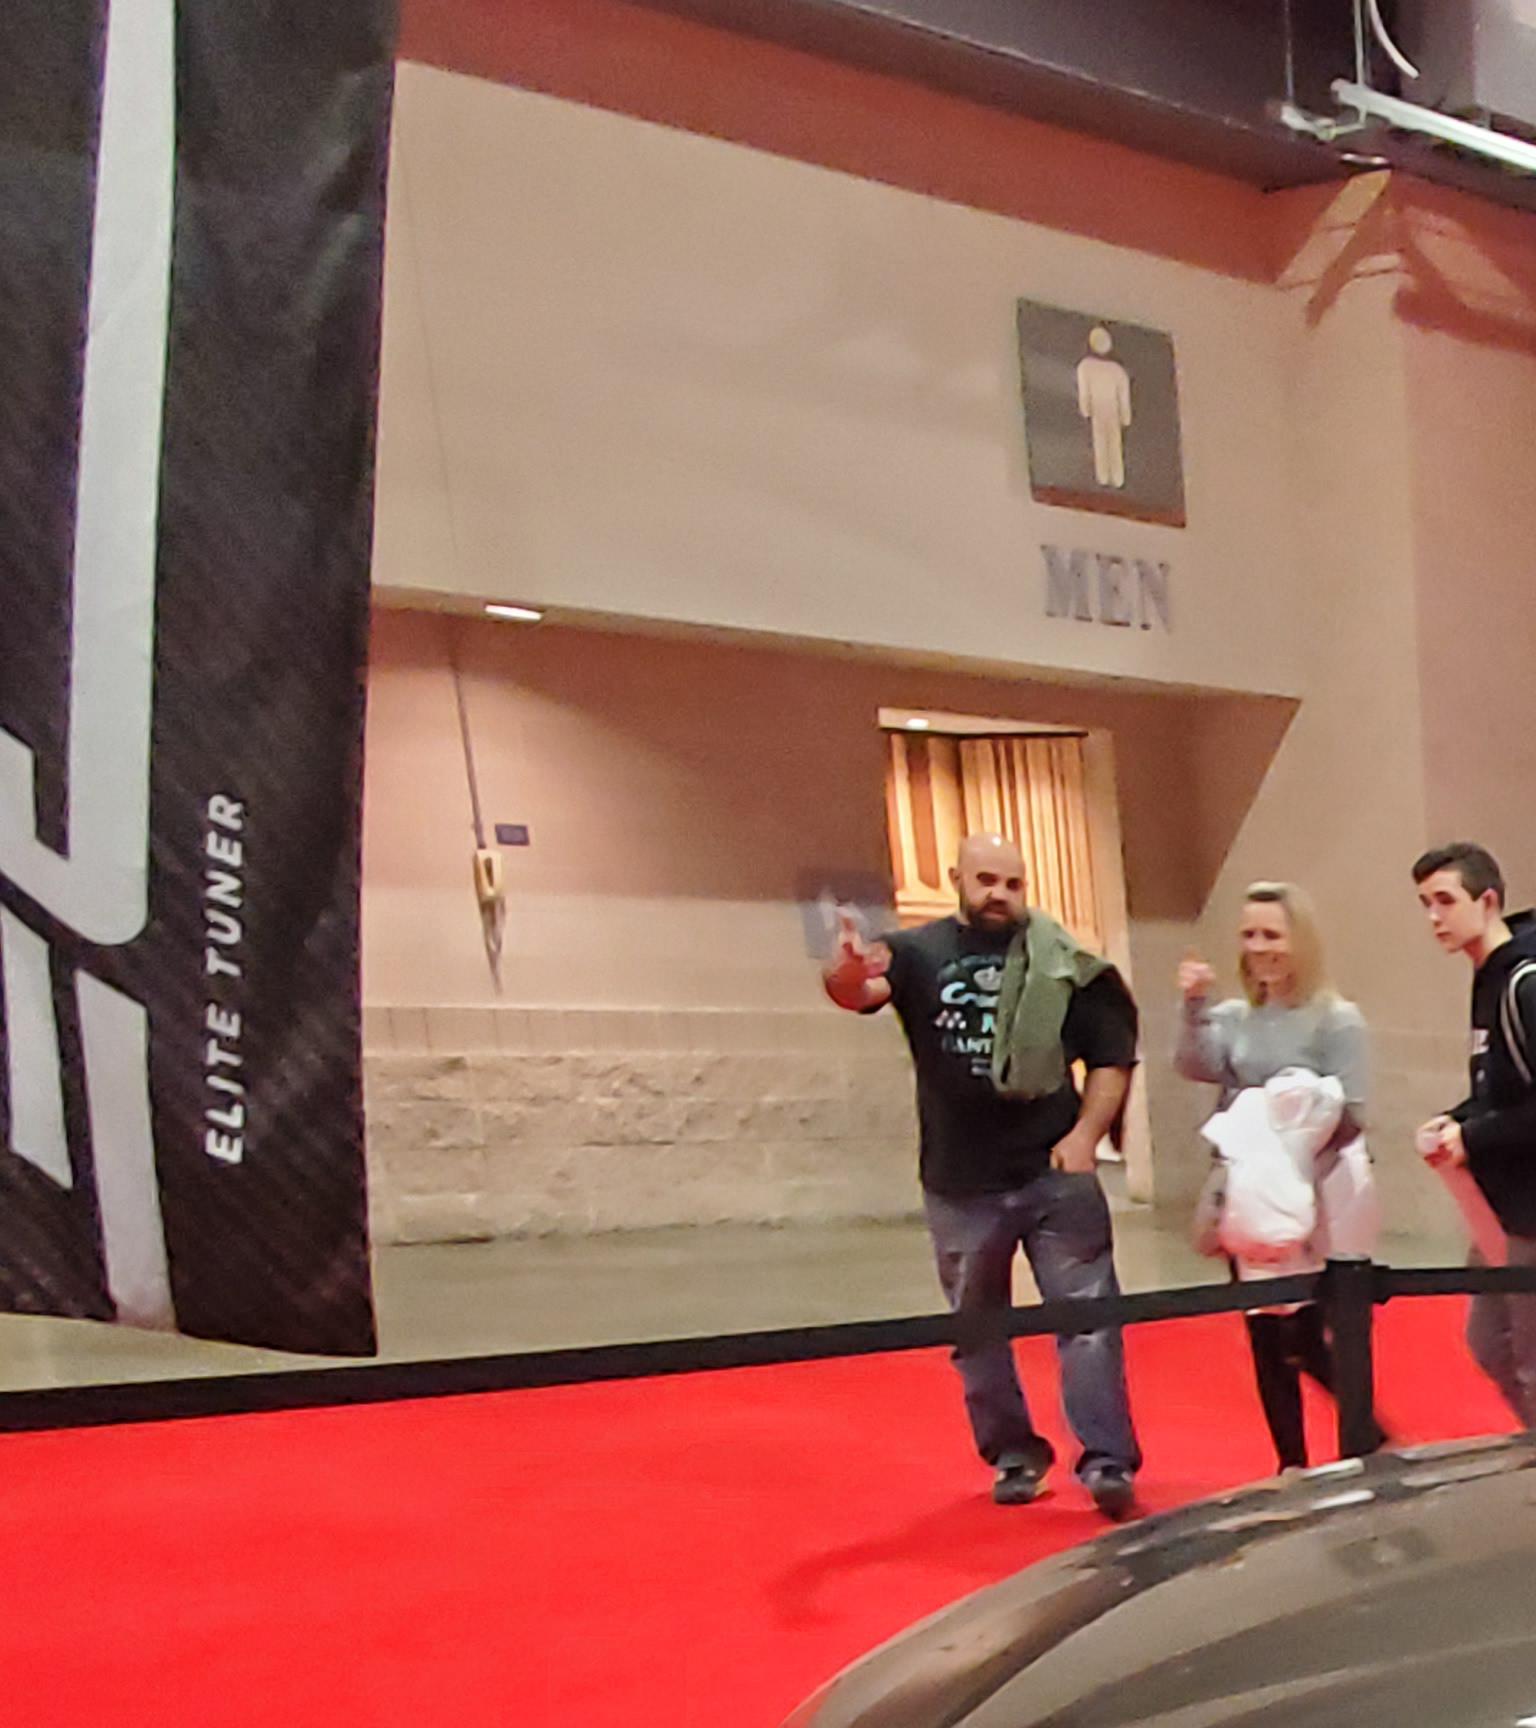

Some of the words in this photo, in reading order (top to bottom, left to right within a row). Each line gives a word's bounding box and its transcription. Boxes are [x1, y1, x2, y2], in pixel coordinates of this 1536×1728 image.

[1041, 545, 1171, 634] MEN
[206, 793, 244, 979] TUNER
[205, 1001, 243, 1165] ELITE
